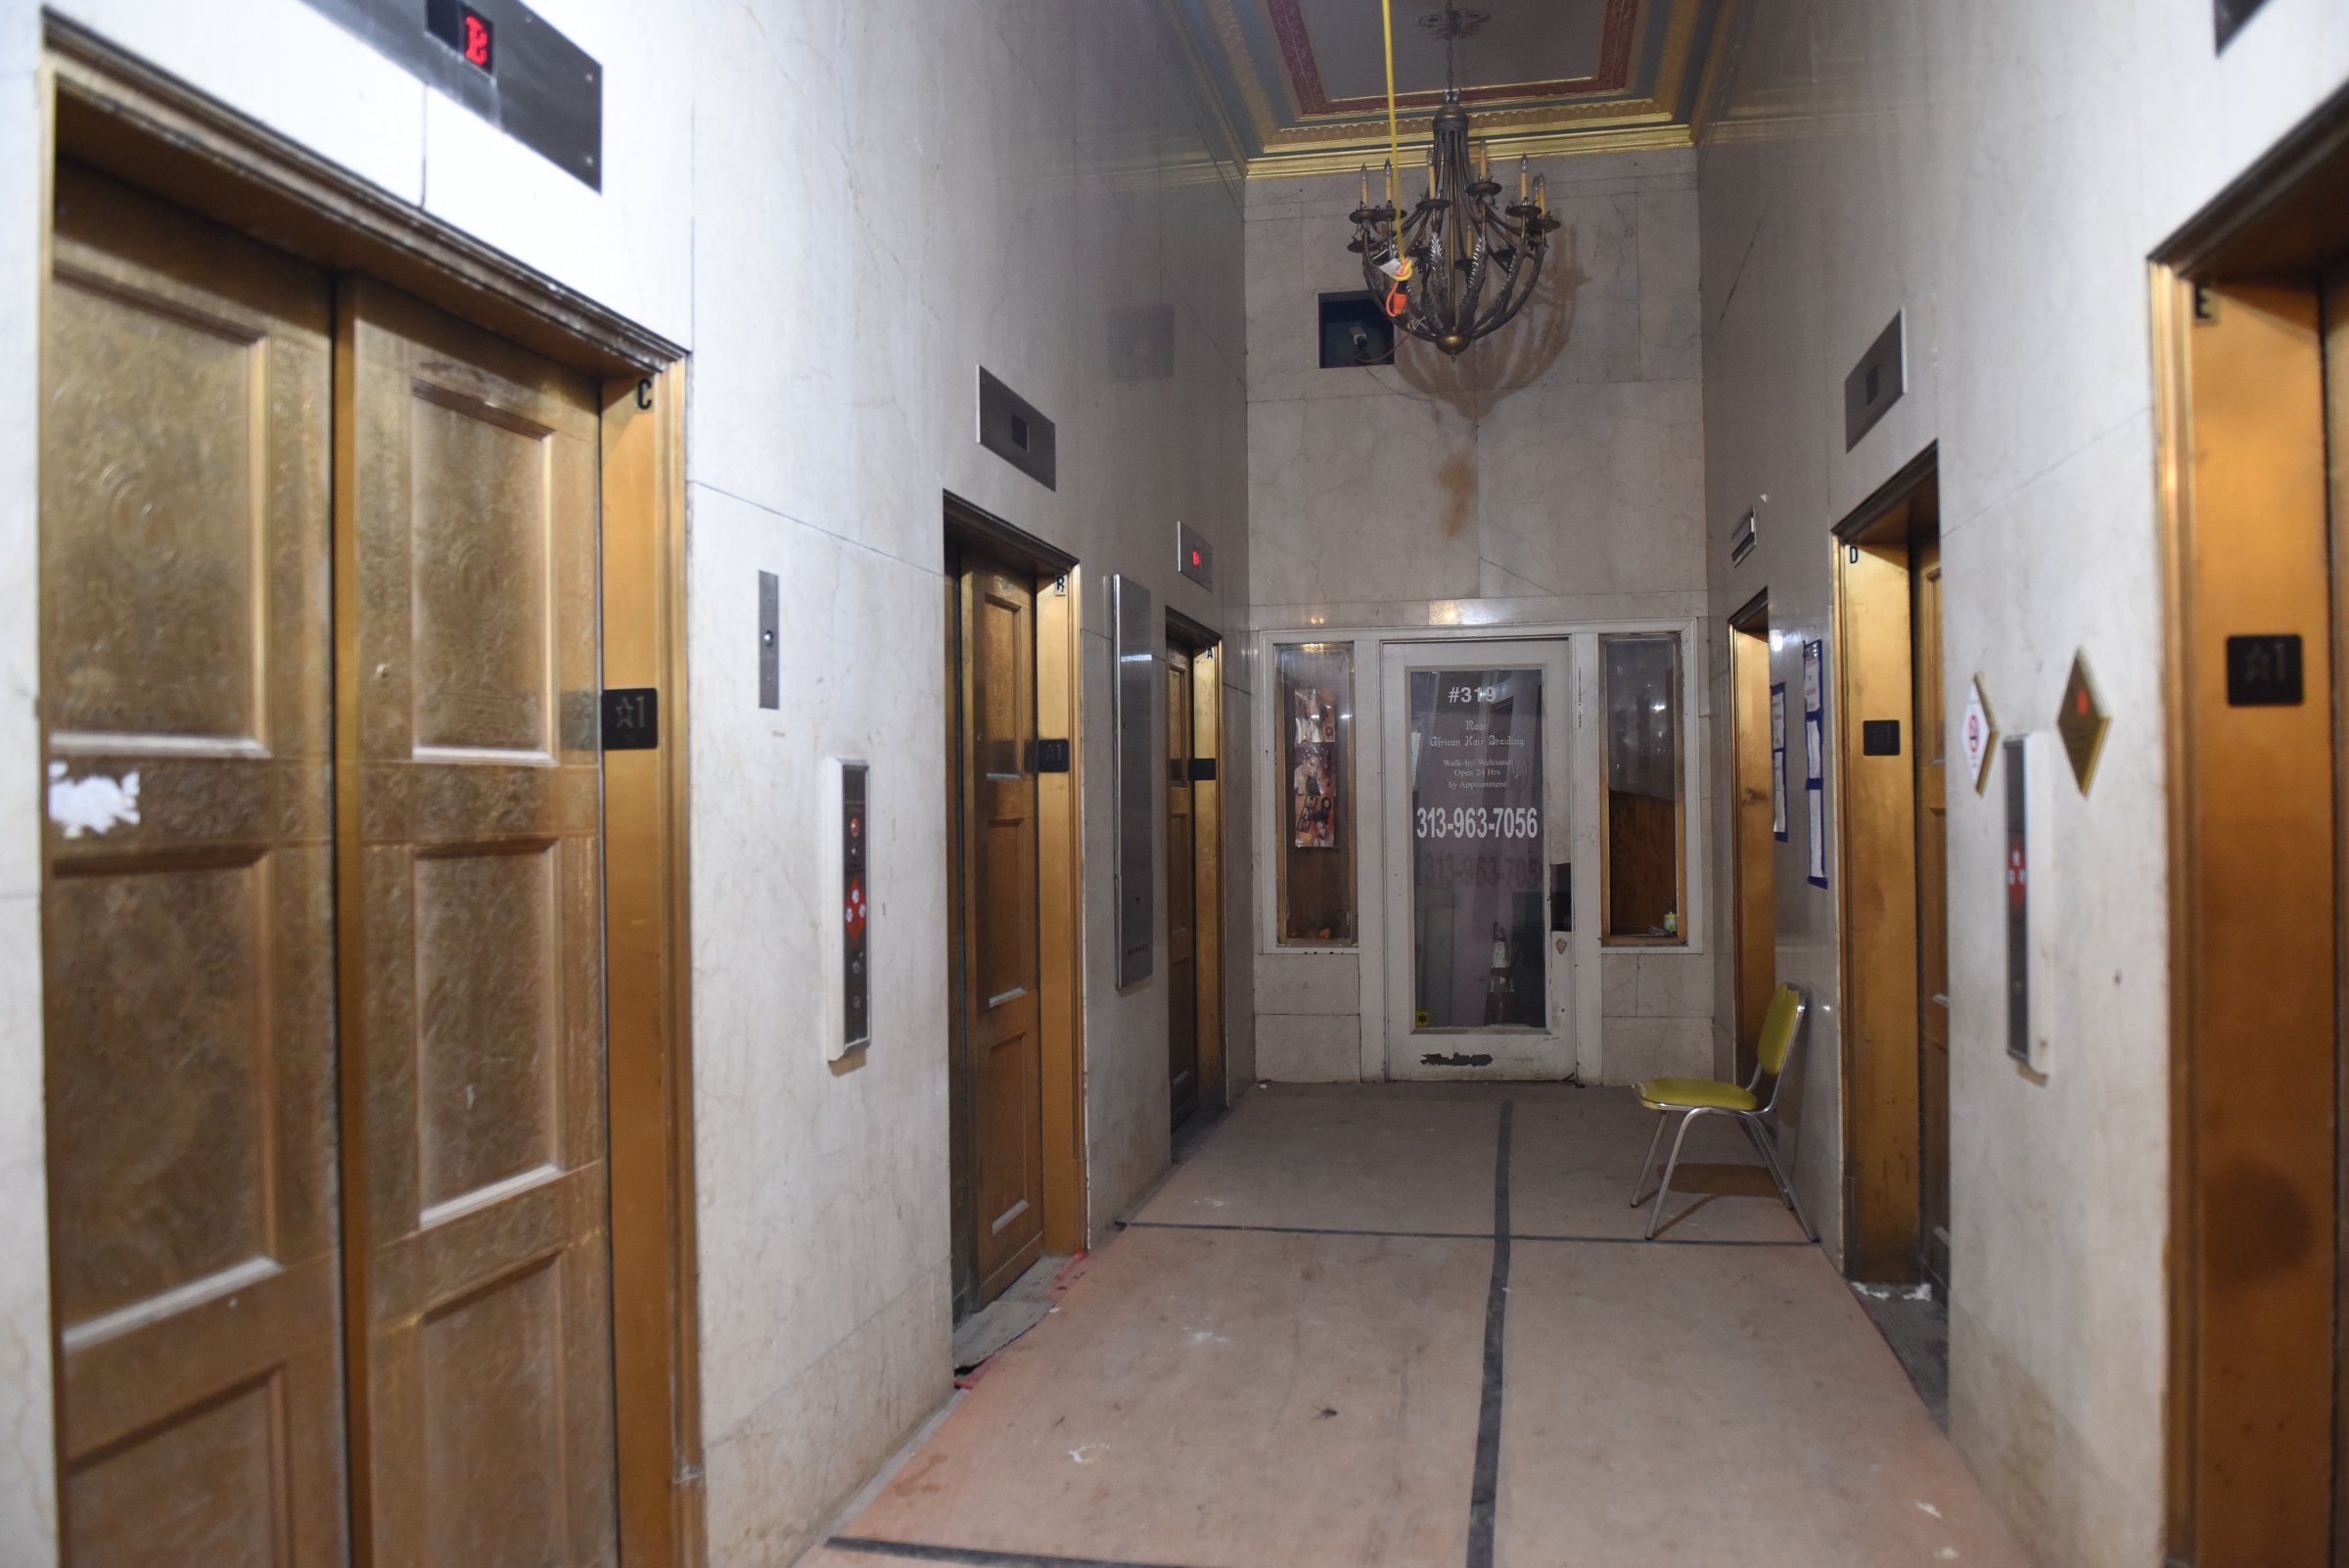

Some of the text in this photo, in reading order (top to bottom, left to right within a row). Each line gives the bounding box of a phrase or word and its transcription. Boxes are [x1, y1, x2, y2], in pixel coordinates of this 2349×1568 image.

[637, 377, 654, 411] C
[1849, 546, 1859, 565] D
[1449, 686, 1497, 704] #319
[1429, 734, 1525, 748] African Hair Braiding
[1449, 781, 1456, 791] by
[1416, 807, 1539, 839] 313-963-7056
